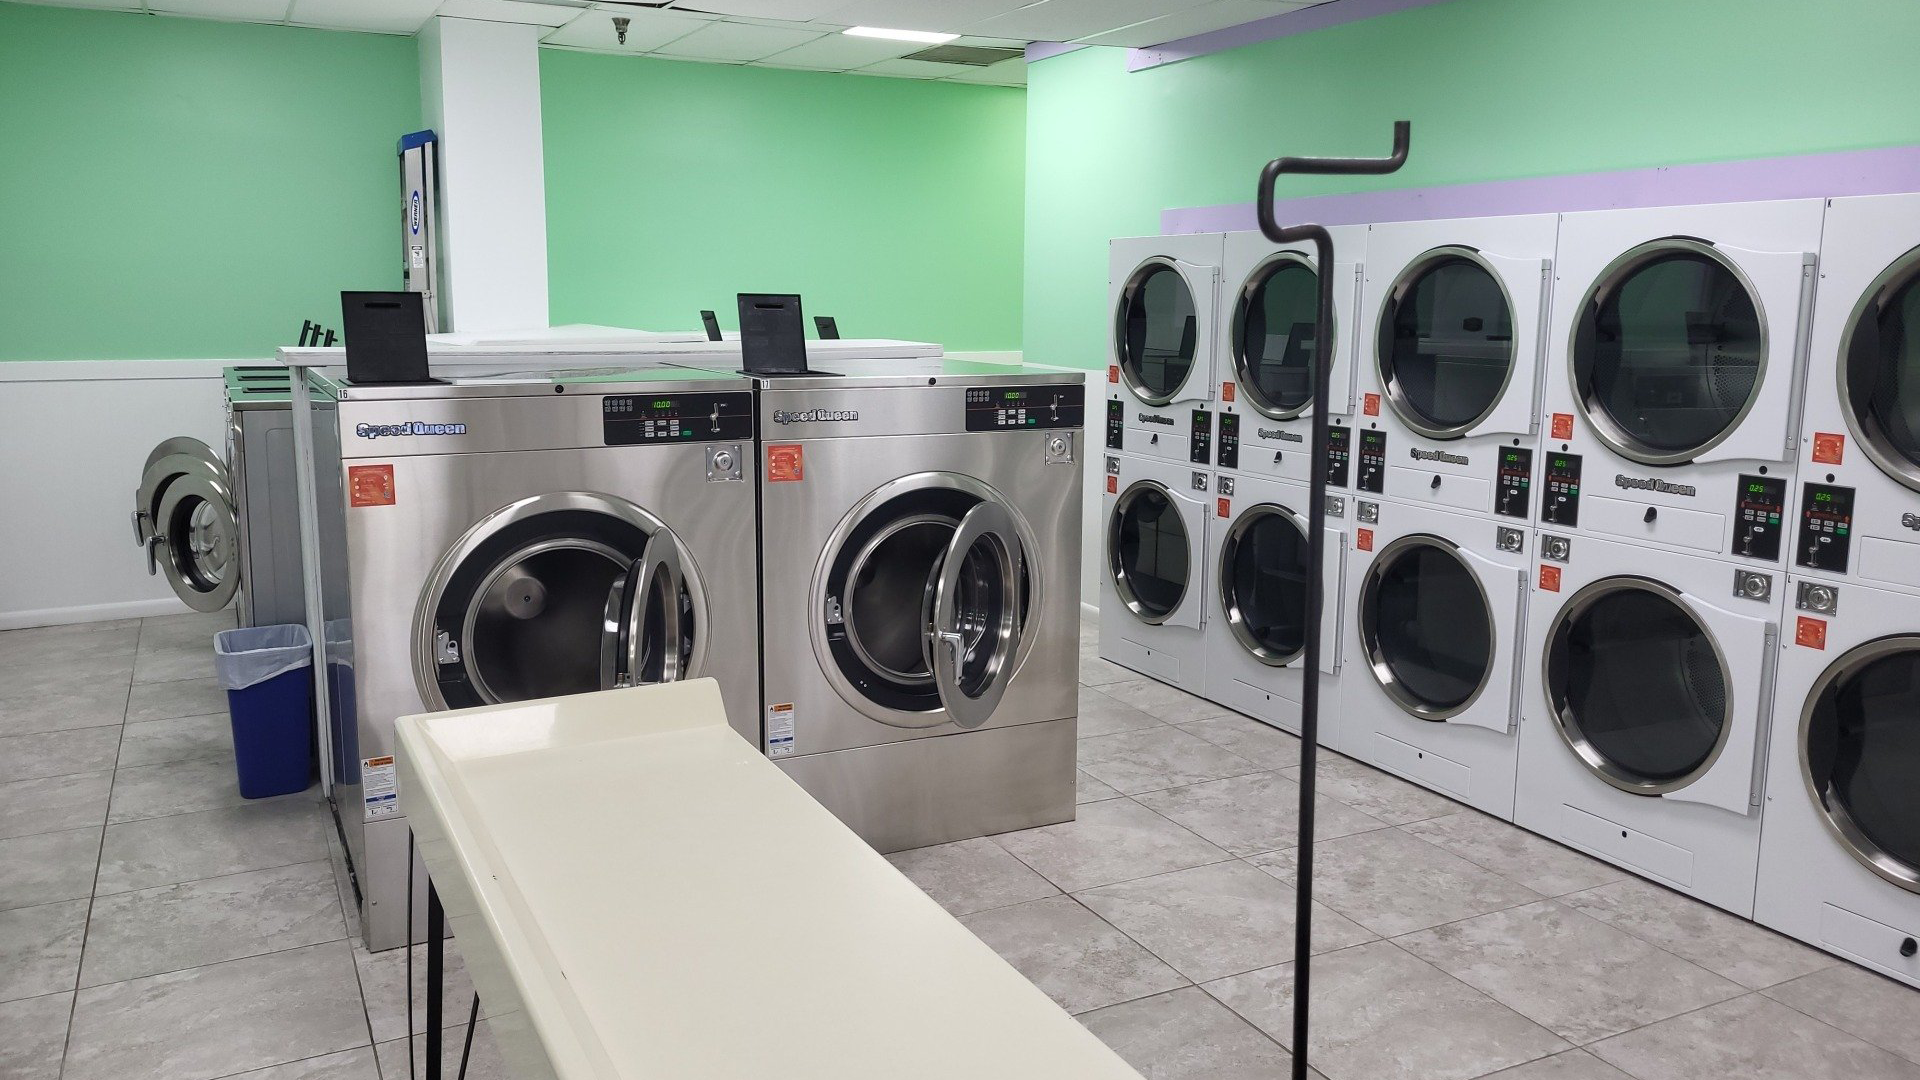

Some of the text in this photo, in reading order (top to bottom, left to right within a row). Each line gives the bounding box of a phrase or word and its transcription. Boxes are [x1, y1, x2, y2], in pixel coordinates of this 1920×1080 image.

[762, 380, 769, 388] 17
[339, 389, 348, 399] 16
[774, 409, 858, 425] Speed Queen
[356, 421, 466, 439] Speed Queen
[1410, 447, 1440, 461] Speed
[1615, 474, 1696, 497] Speed Queen
